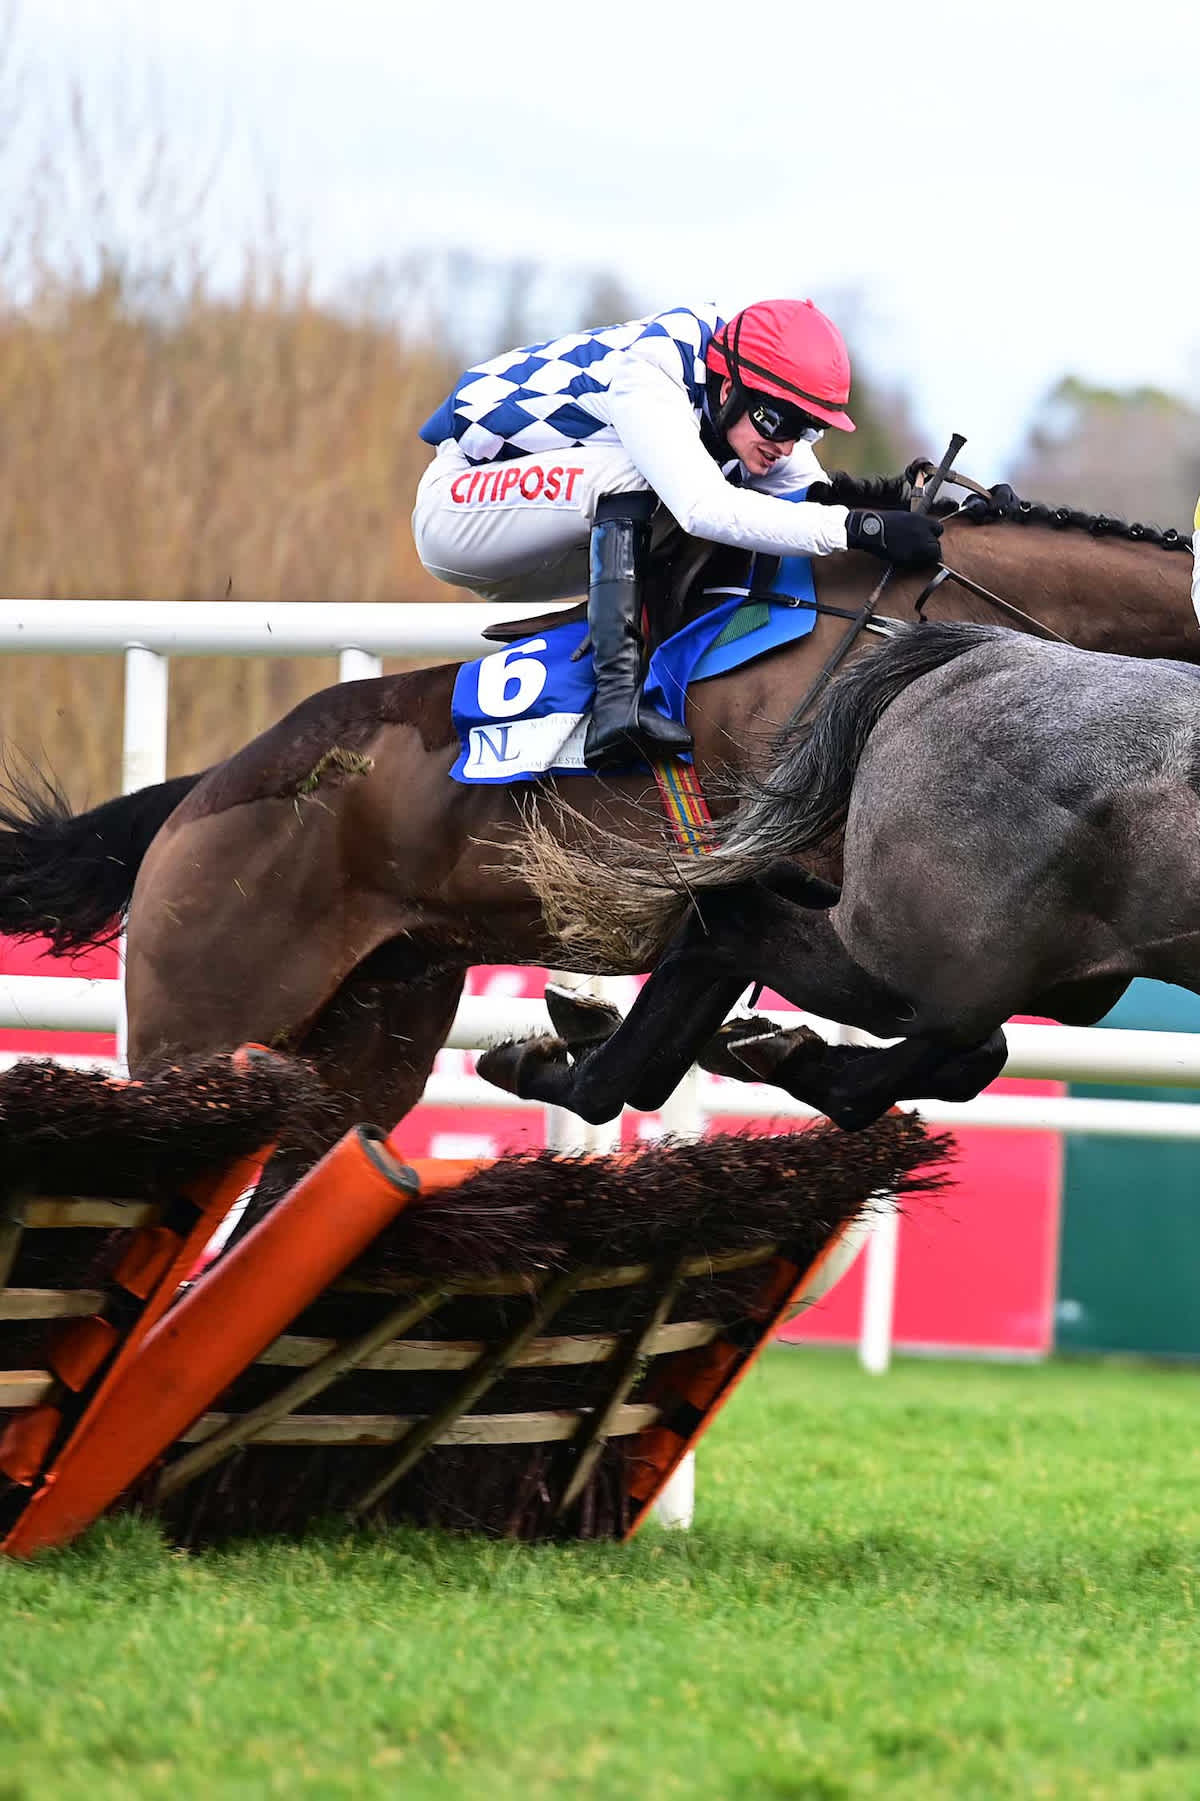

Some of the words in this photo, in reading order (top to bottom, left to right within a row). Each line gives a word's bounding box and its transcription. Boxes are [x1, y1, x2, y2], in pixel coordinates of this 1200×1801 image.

[451, 465, 584, 503] CITIPOST
[477, 639, 547, 718] 6
[472, 725, 521, 765] NL
